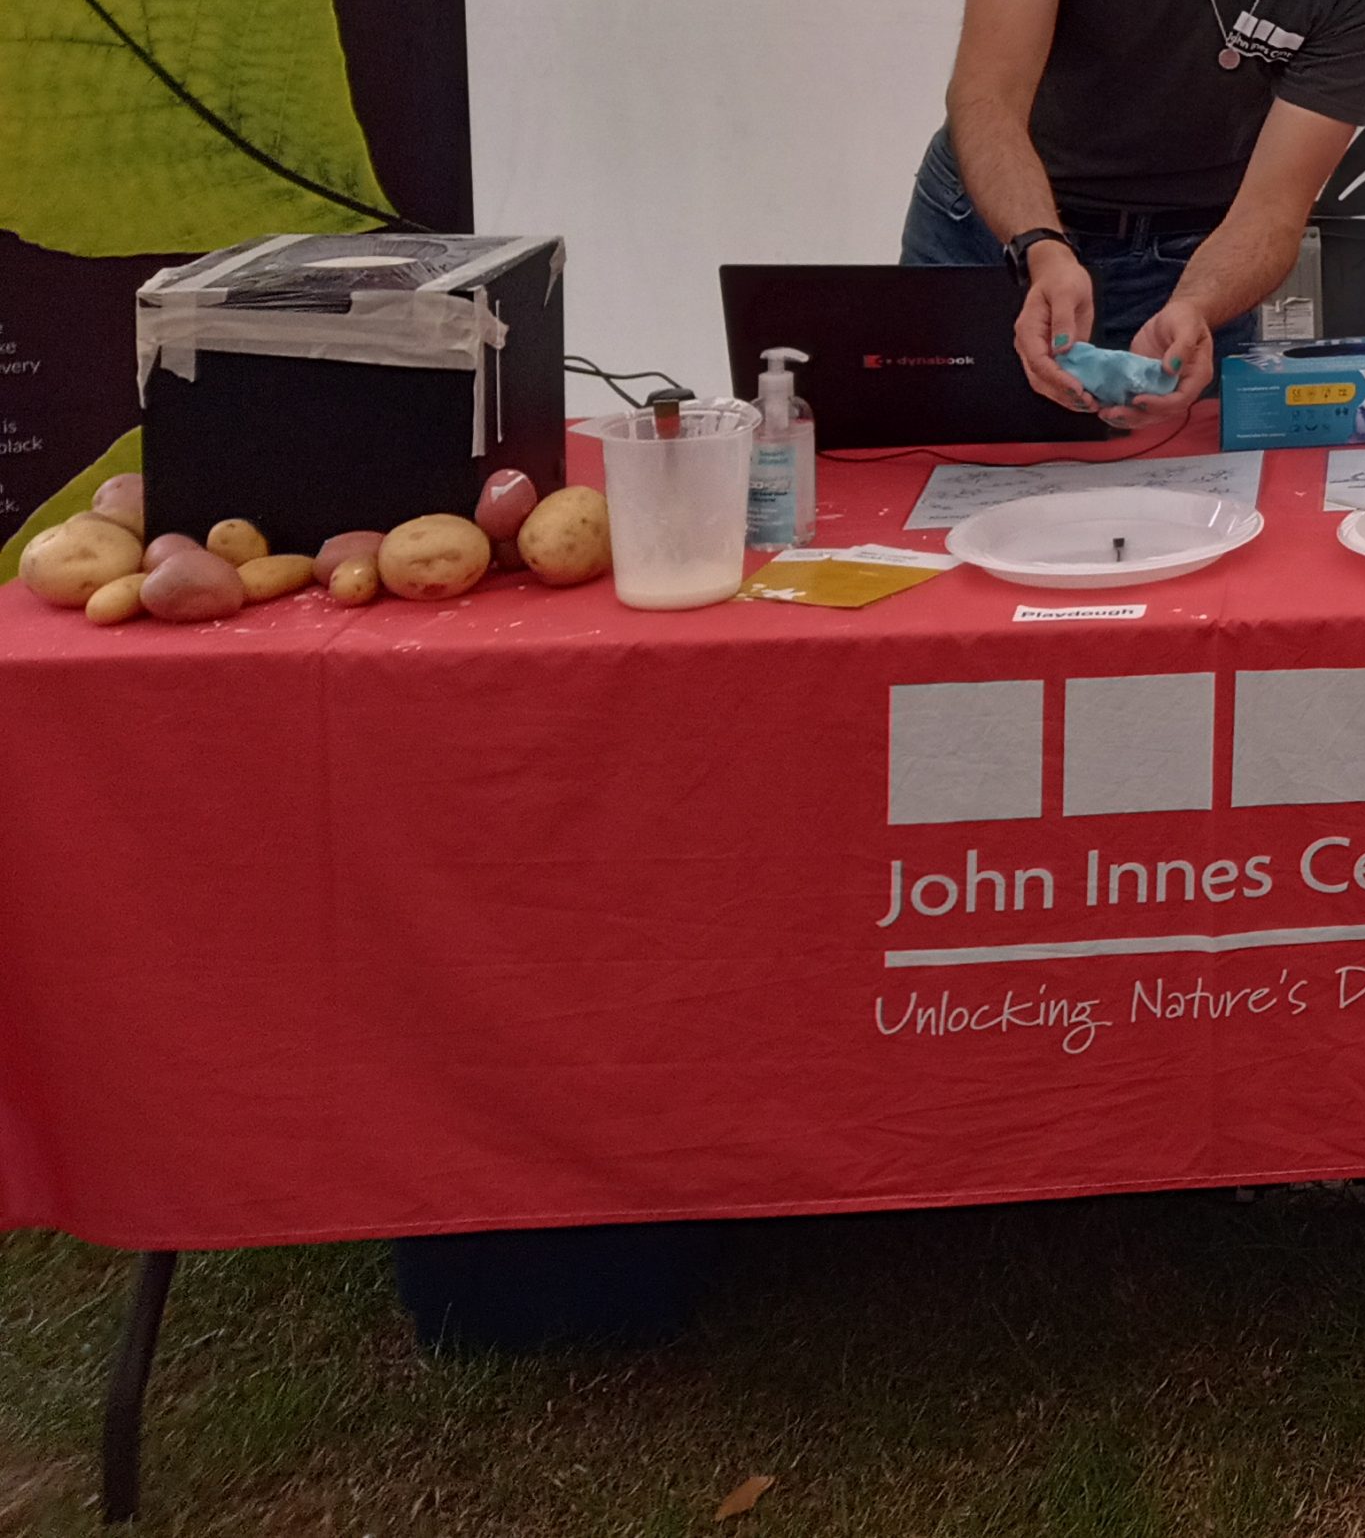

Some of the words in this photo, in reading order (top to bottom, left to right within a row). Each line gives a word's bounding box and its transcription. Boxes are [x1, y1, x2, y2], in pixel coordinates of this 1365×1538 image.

[898, 356, 975, 366] dynabook
[1021, 608, 1134, 618] Playdough
[876, 849, 1055, 928] John
[1086, 849, 1273, 906] Innes
[875, 984, 1113, 1055] Unlocking
[1130, 969, 1308, 1024] Nature's
